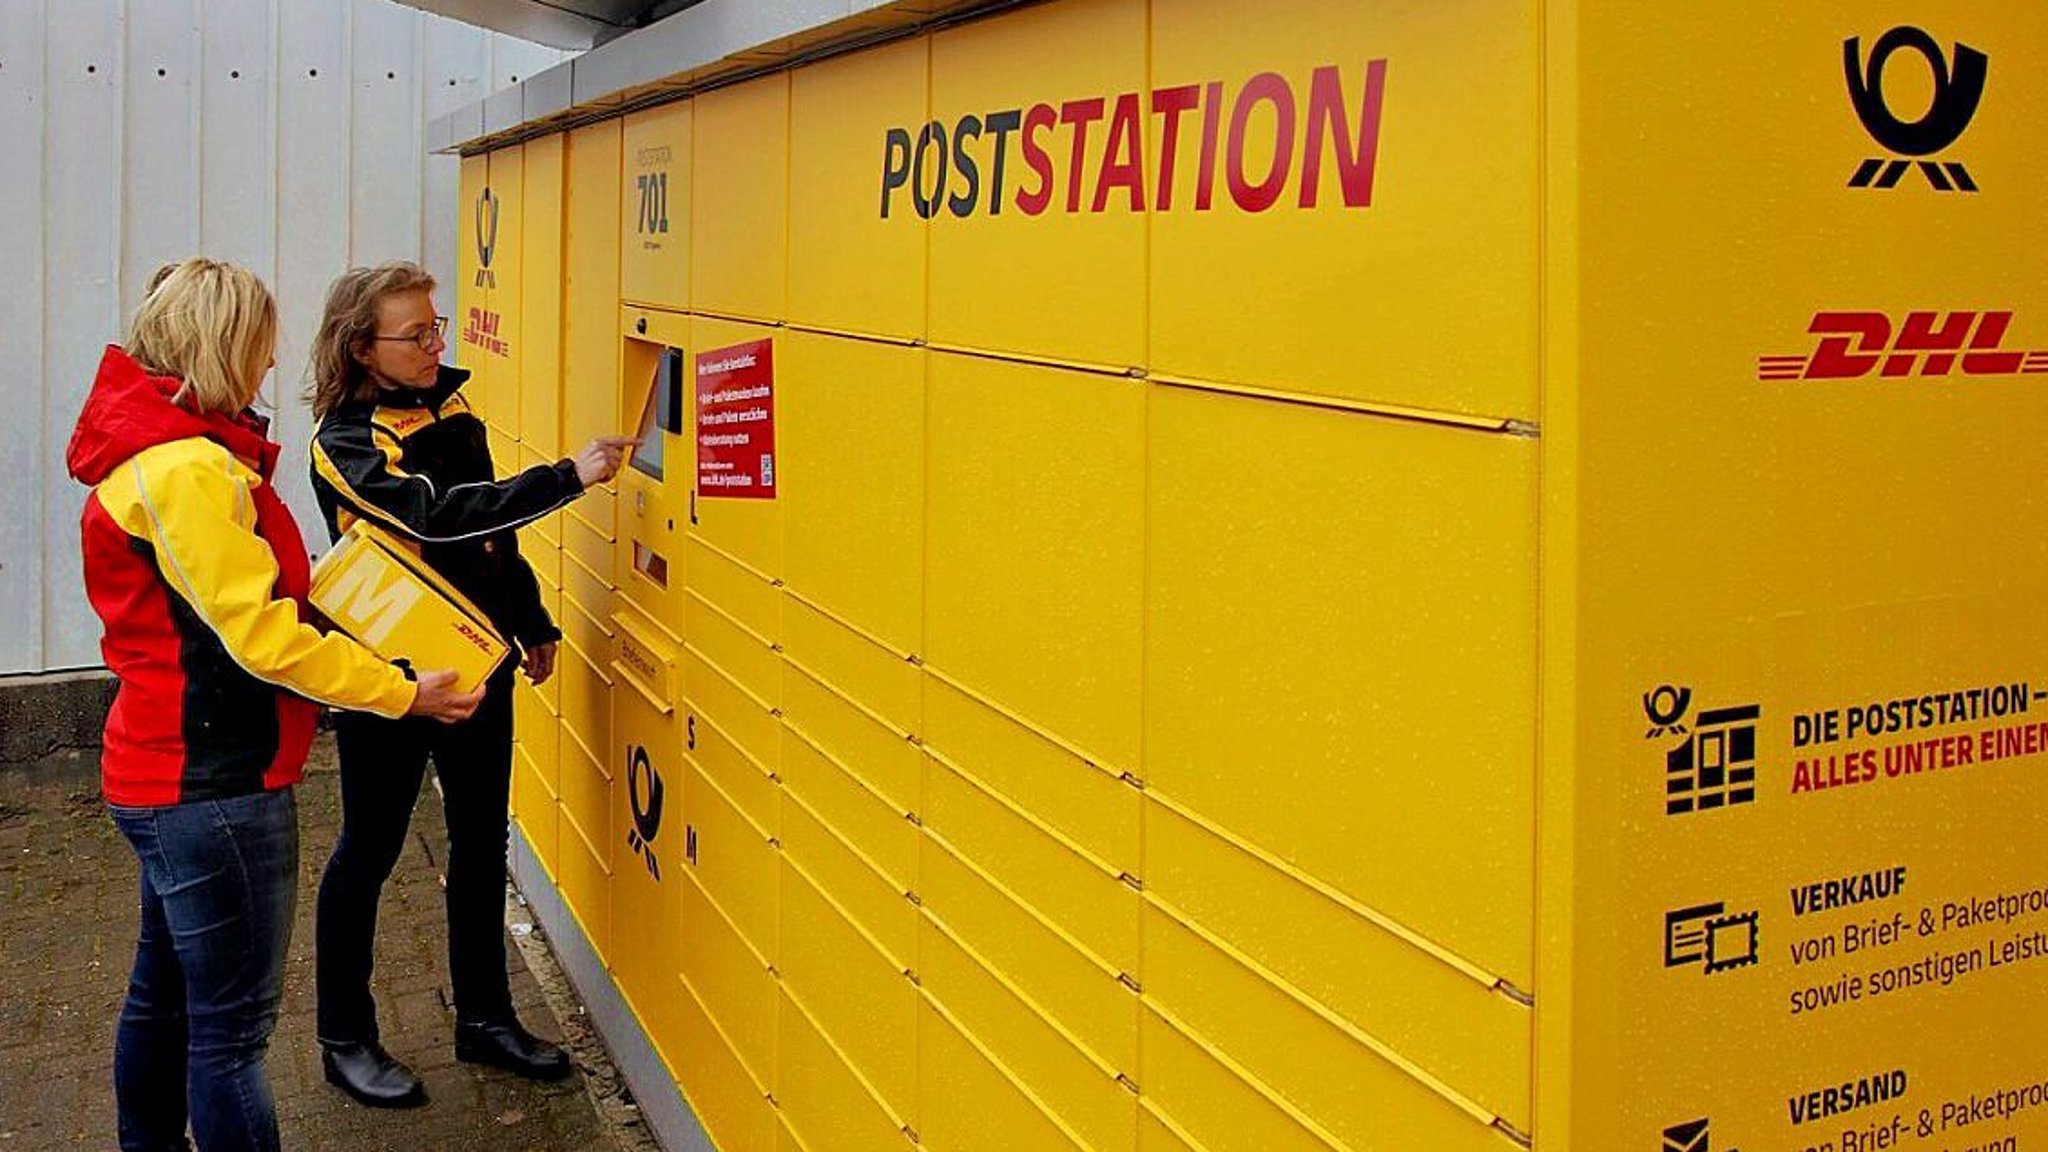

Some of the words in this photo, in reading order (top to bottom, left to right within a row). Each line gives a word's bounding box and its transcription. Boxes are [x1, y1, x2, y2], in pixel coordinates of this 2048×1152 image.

[880, 59, 1388, 220] POSTSTATION
[638, 173, 668, 234] 701
[468, 307, 503, 355] DHL
[1796, 311, 2028, 380] DHL
[321, 547, 423, 648] M
[455, 622, 491, 653] DHL
[687, 713, 696, 751] S
[1793, 709, 1839, 748] DIE
[1847, 682, 2028, 740] POSTSTATION
[1791, 749, 1878, 794] ALLES
[1884, 735, 1973, 778] UNTER
[686, 824, 697, 867] M
[1790, 866, 1907, 917] VERKAUF
[1790, 933, 1835, 965] von
[1843, 912, 1911, 953] Brief-
[1917, 907, 1936, 938] &
[1790, 973, 1863, 1015] sowie
[1869, 947, 1983, 996] sonstigen
[1788, 1069, 1907, 1126] VERSAND
[1842, 1114, 1911, 1152] Brief-
[1916, 1109, 1935, 1139] &
